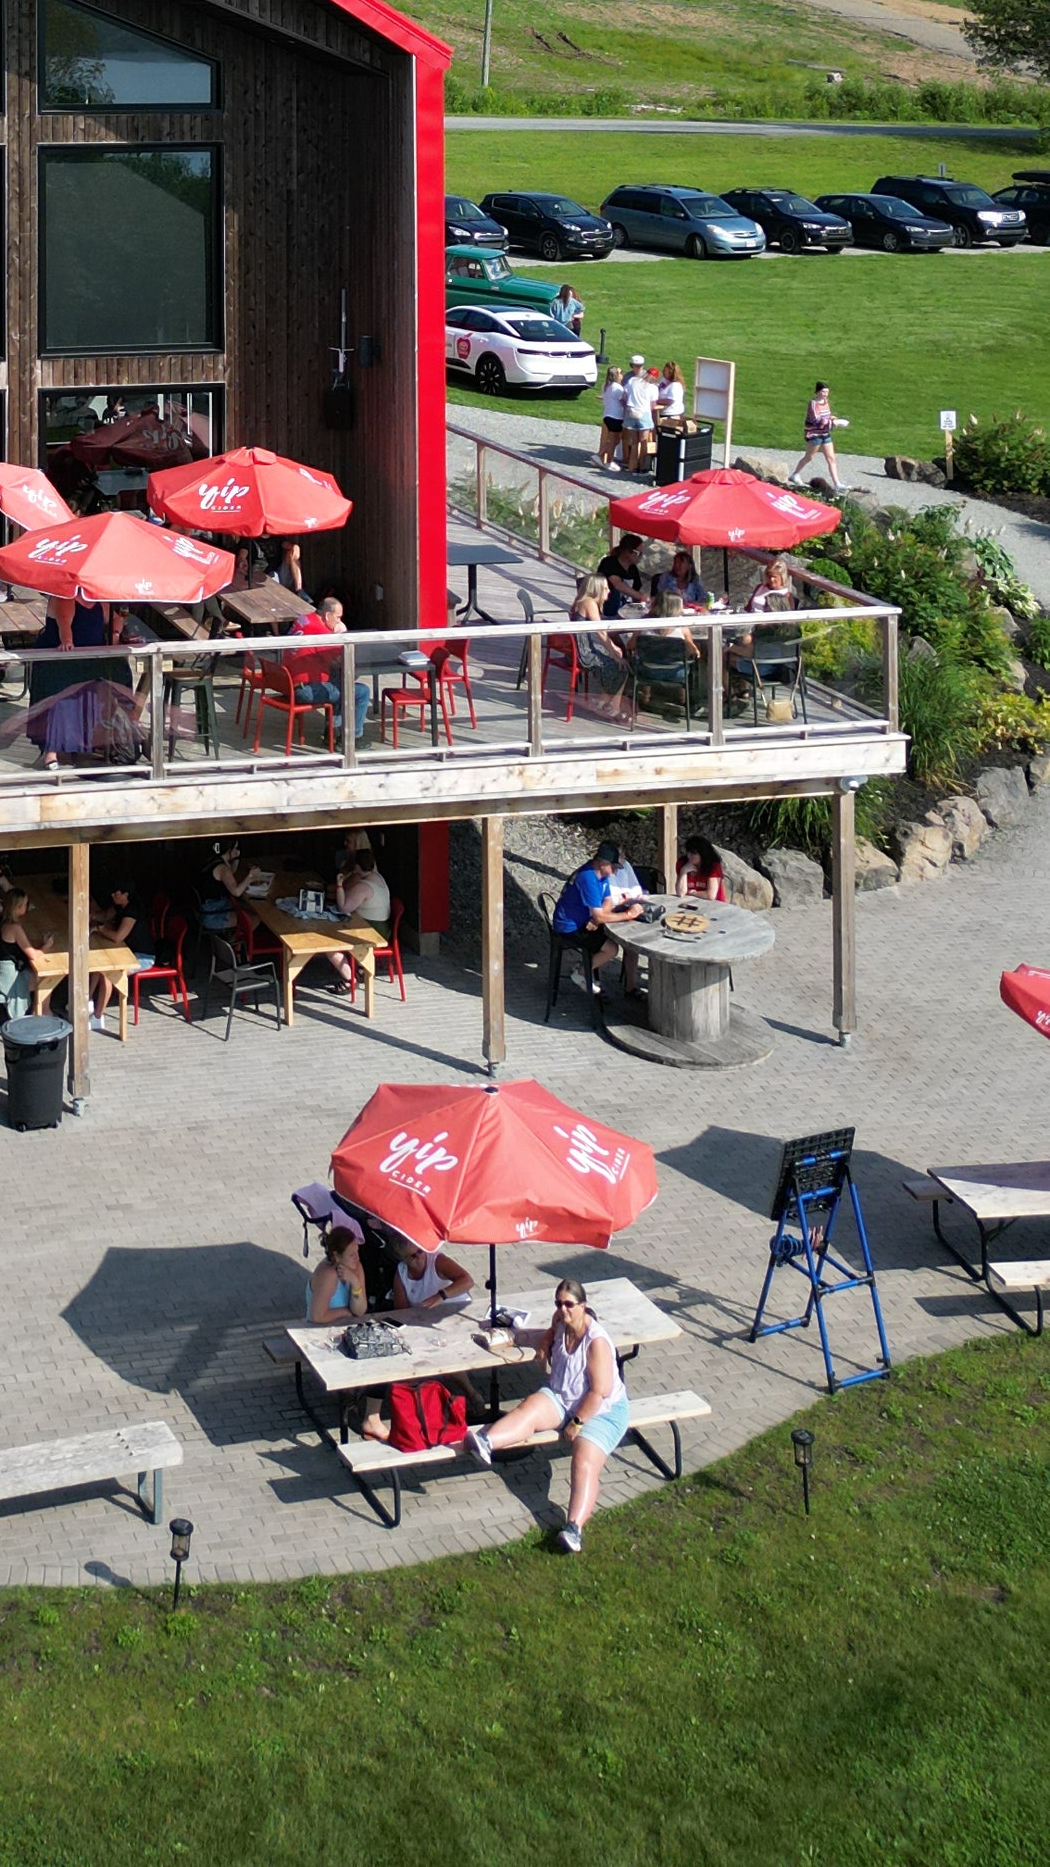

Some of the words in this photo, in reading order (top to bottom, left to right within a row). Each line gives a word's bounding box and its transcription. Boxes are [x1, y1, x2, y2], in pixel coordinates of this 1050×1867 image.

[197, 477, 250, 510] yip
[637, 489, 691, 510] yip
[726, 526, 746, 542] yip
[27, 534, 89, 560] yip
[134, 578, 153, 594] yip
[379, 1131, 459, 1175] yip
[553, 1124, 617, 1184] yip
[611, 1147, 627, 1176] CIDER
[391, 1170, 432, 1194] CIDER
[515, 1217, 539, 1239] yip
